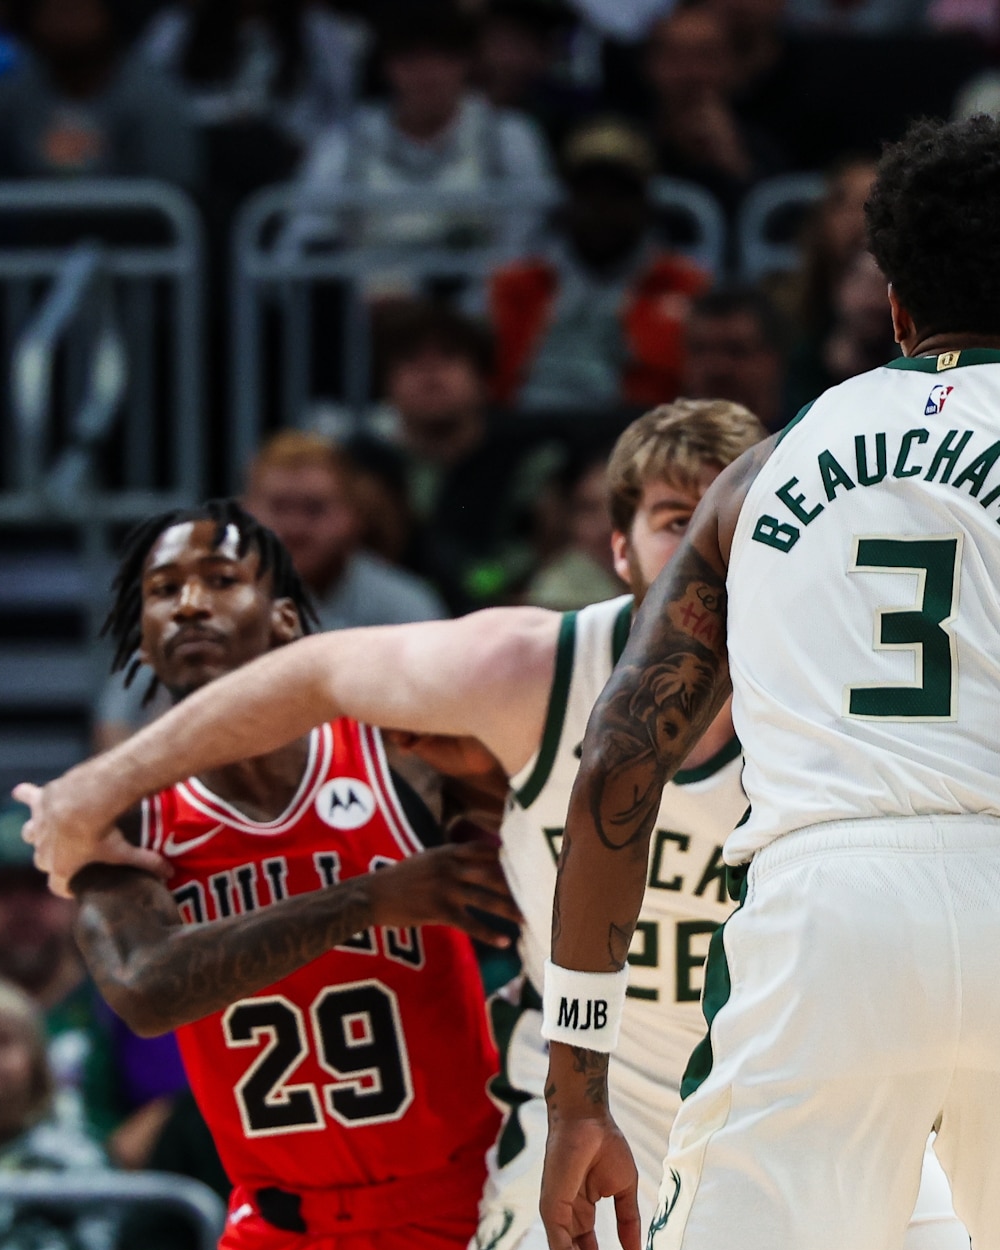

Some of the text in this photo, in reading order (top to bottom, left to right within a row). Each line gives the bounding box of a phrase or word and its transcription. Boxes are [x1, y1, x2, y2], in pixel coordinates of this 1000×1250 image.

[841, 533, 965, 723] 3
[221, 978, 415, 1139] 29
[557, 996, 608, 1030] MJB
